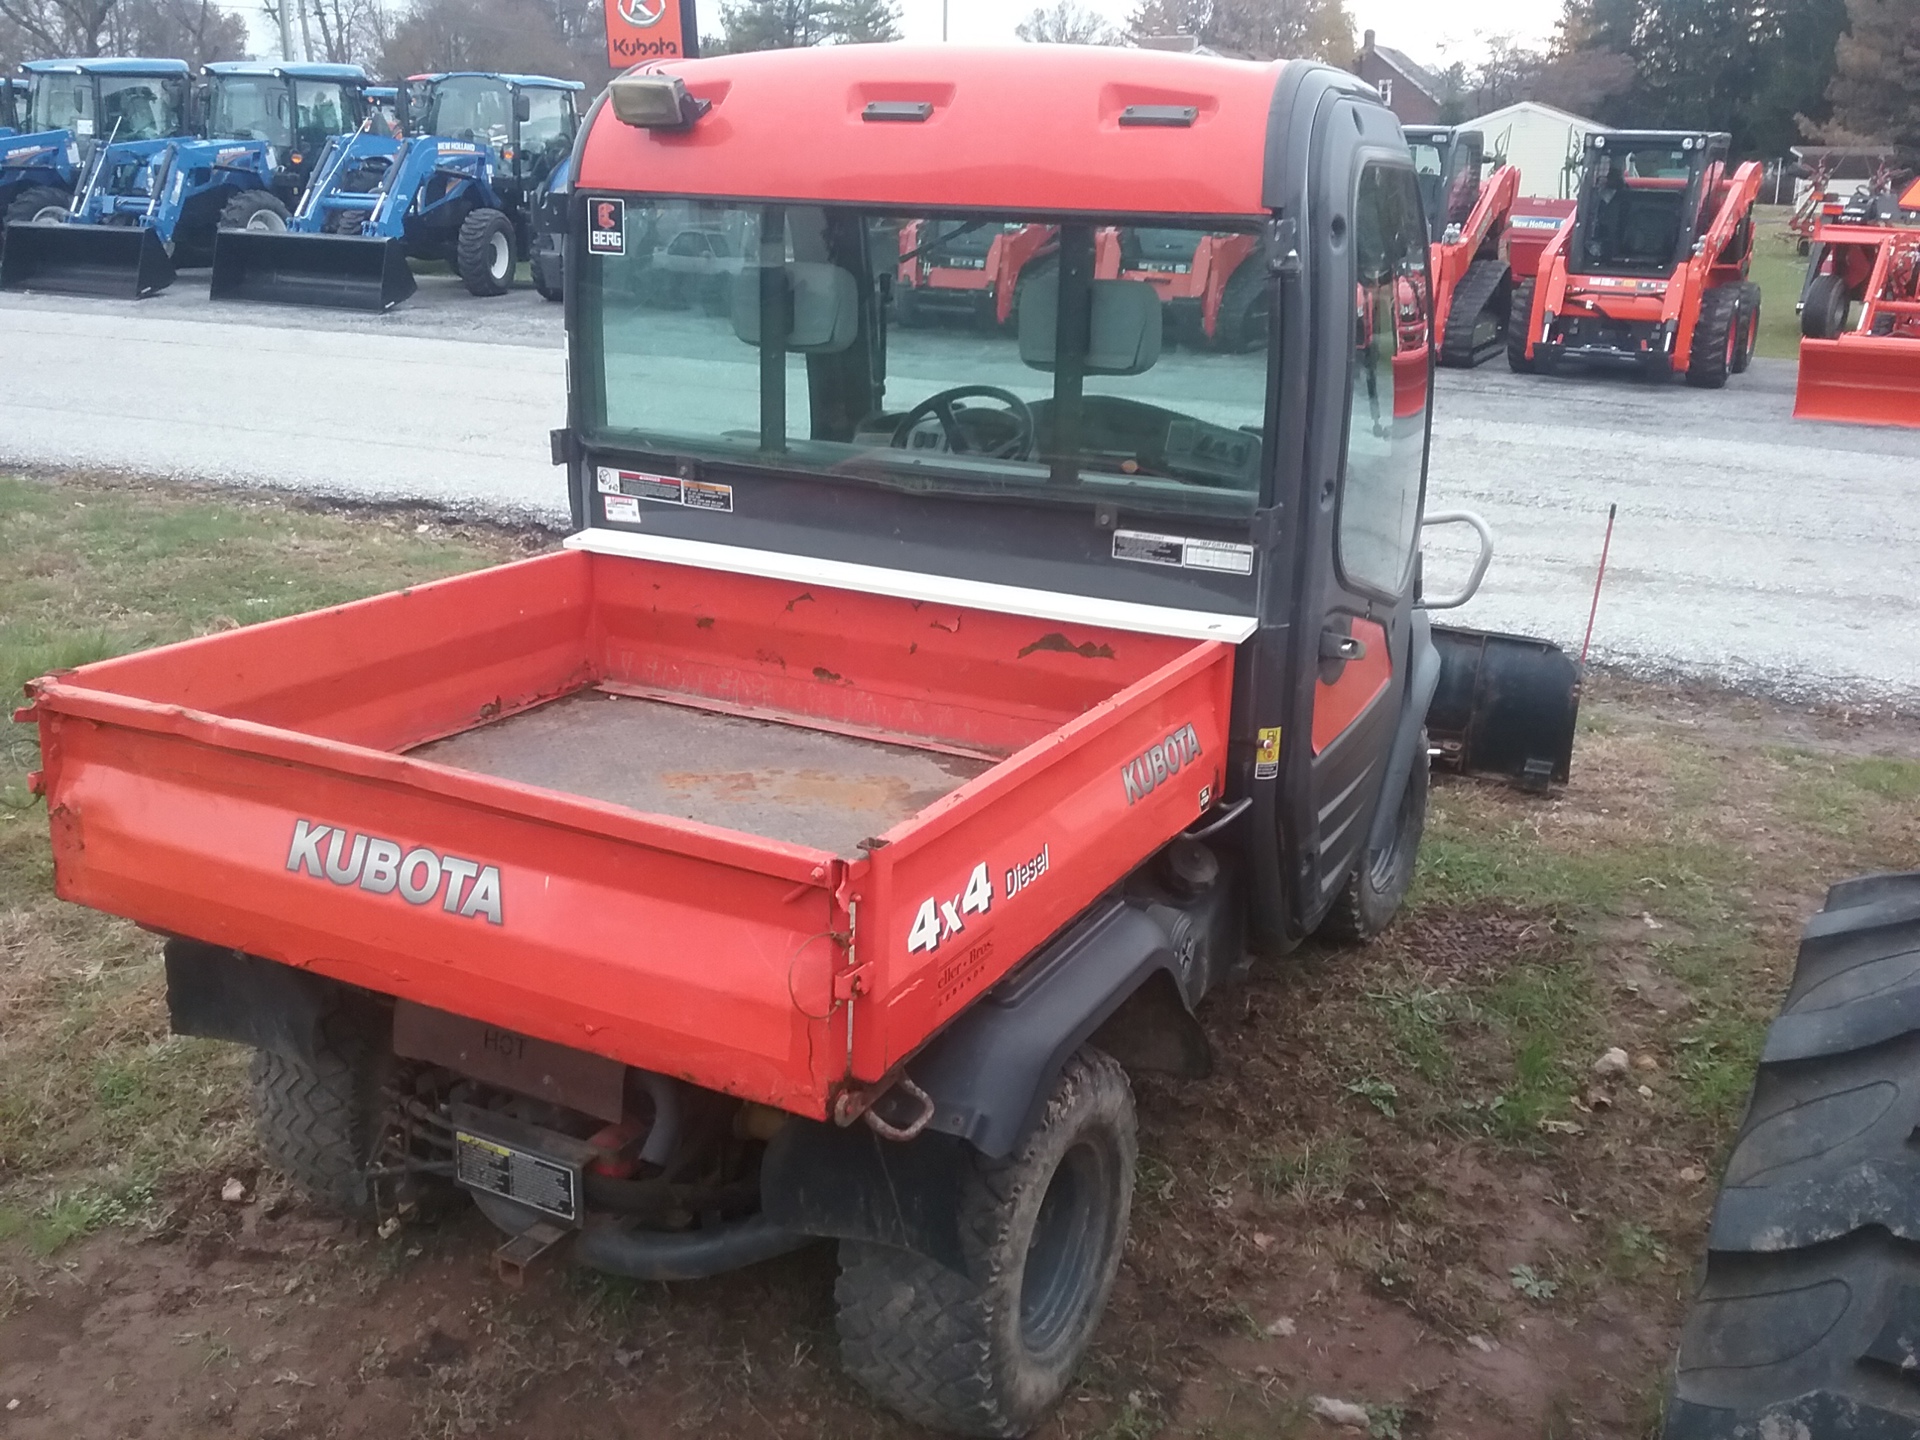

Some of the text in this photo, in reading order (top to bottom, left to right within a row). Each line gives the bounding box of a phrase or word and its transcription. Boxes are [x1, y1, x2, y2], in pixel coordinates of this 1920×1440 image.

[613, 37, 677, 56] Kubota
[592, 230, 622, 246] BERG
[1528, 219, 1556, 229] Holland
[1121, 722, 1203, 805] KUBOTA
[286, 819, 503, 925] KUBOTA
[907, 842, 1049, 956] 4x4 Diesel
[484, 1028, 527, 1060] HOT
